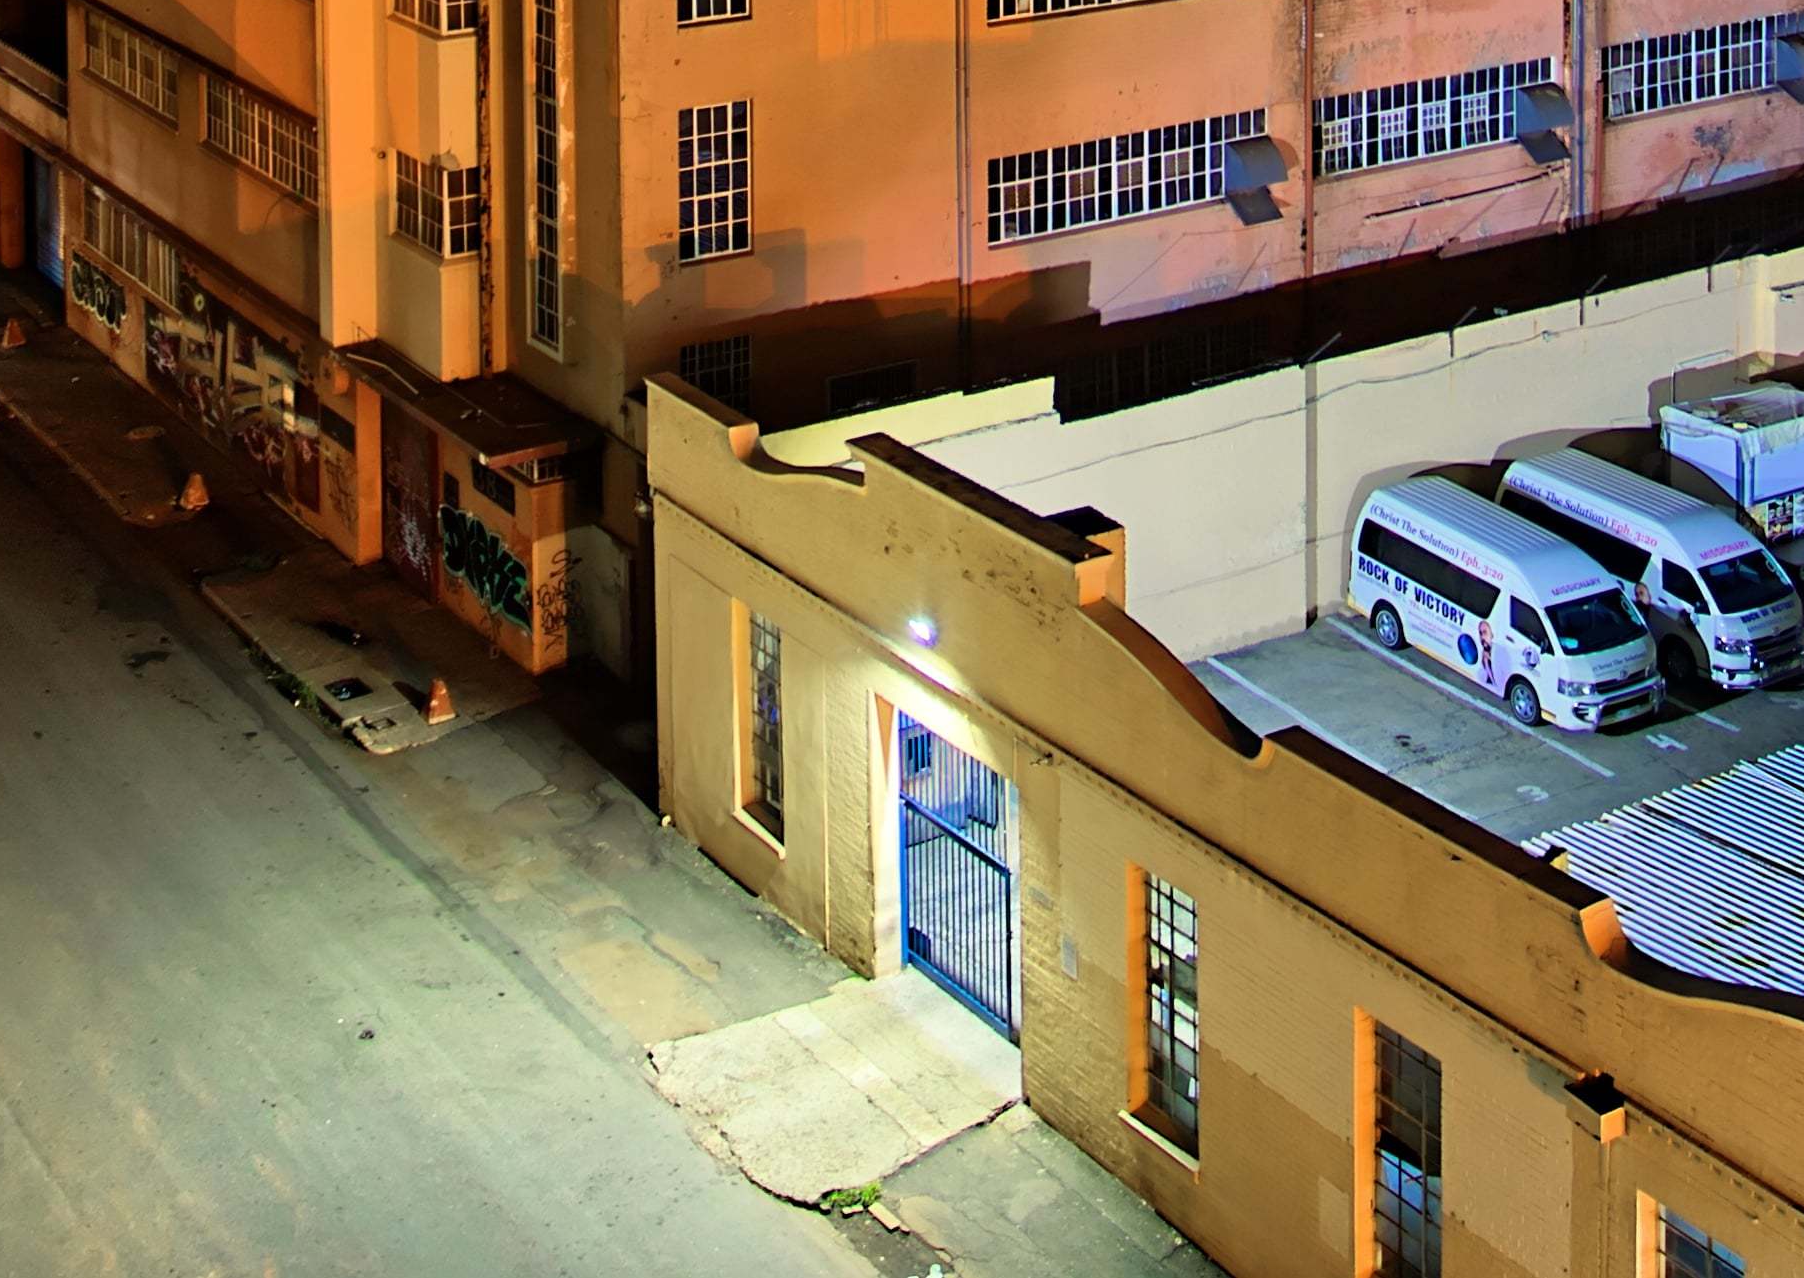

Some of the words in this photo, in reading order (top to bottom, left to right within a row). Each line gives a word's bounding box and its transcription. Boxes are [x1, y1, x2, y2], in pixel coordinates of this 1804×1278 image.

[1508, 475, 1541, 497] (Christ
[1545, 491, 1563, 506] The
[1565, 499, 1609, 528] Solution)
[1370, 504, 1401, 527] (Christ
[1401, 520, 1417, 536] The
[1419, 529, 1460, 558] Solution)
[1461, 552, 1481, 571] Eph.
[1699, 540, 1750, 560] MISSIONARY
[1358, 555, 1389, 585] ROCK
[1394, 576, 1409, 595] OF
[1414, 586, 1465, 626] VICTORY
[1551, 577, 1601, 597] MISSIONARY
[1645, 732, 1689, 751] 4
